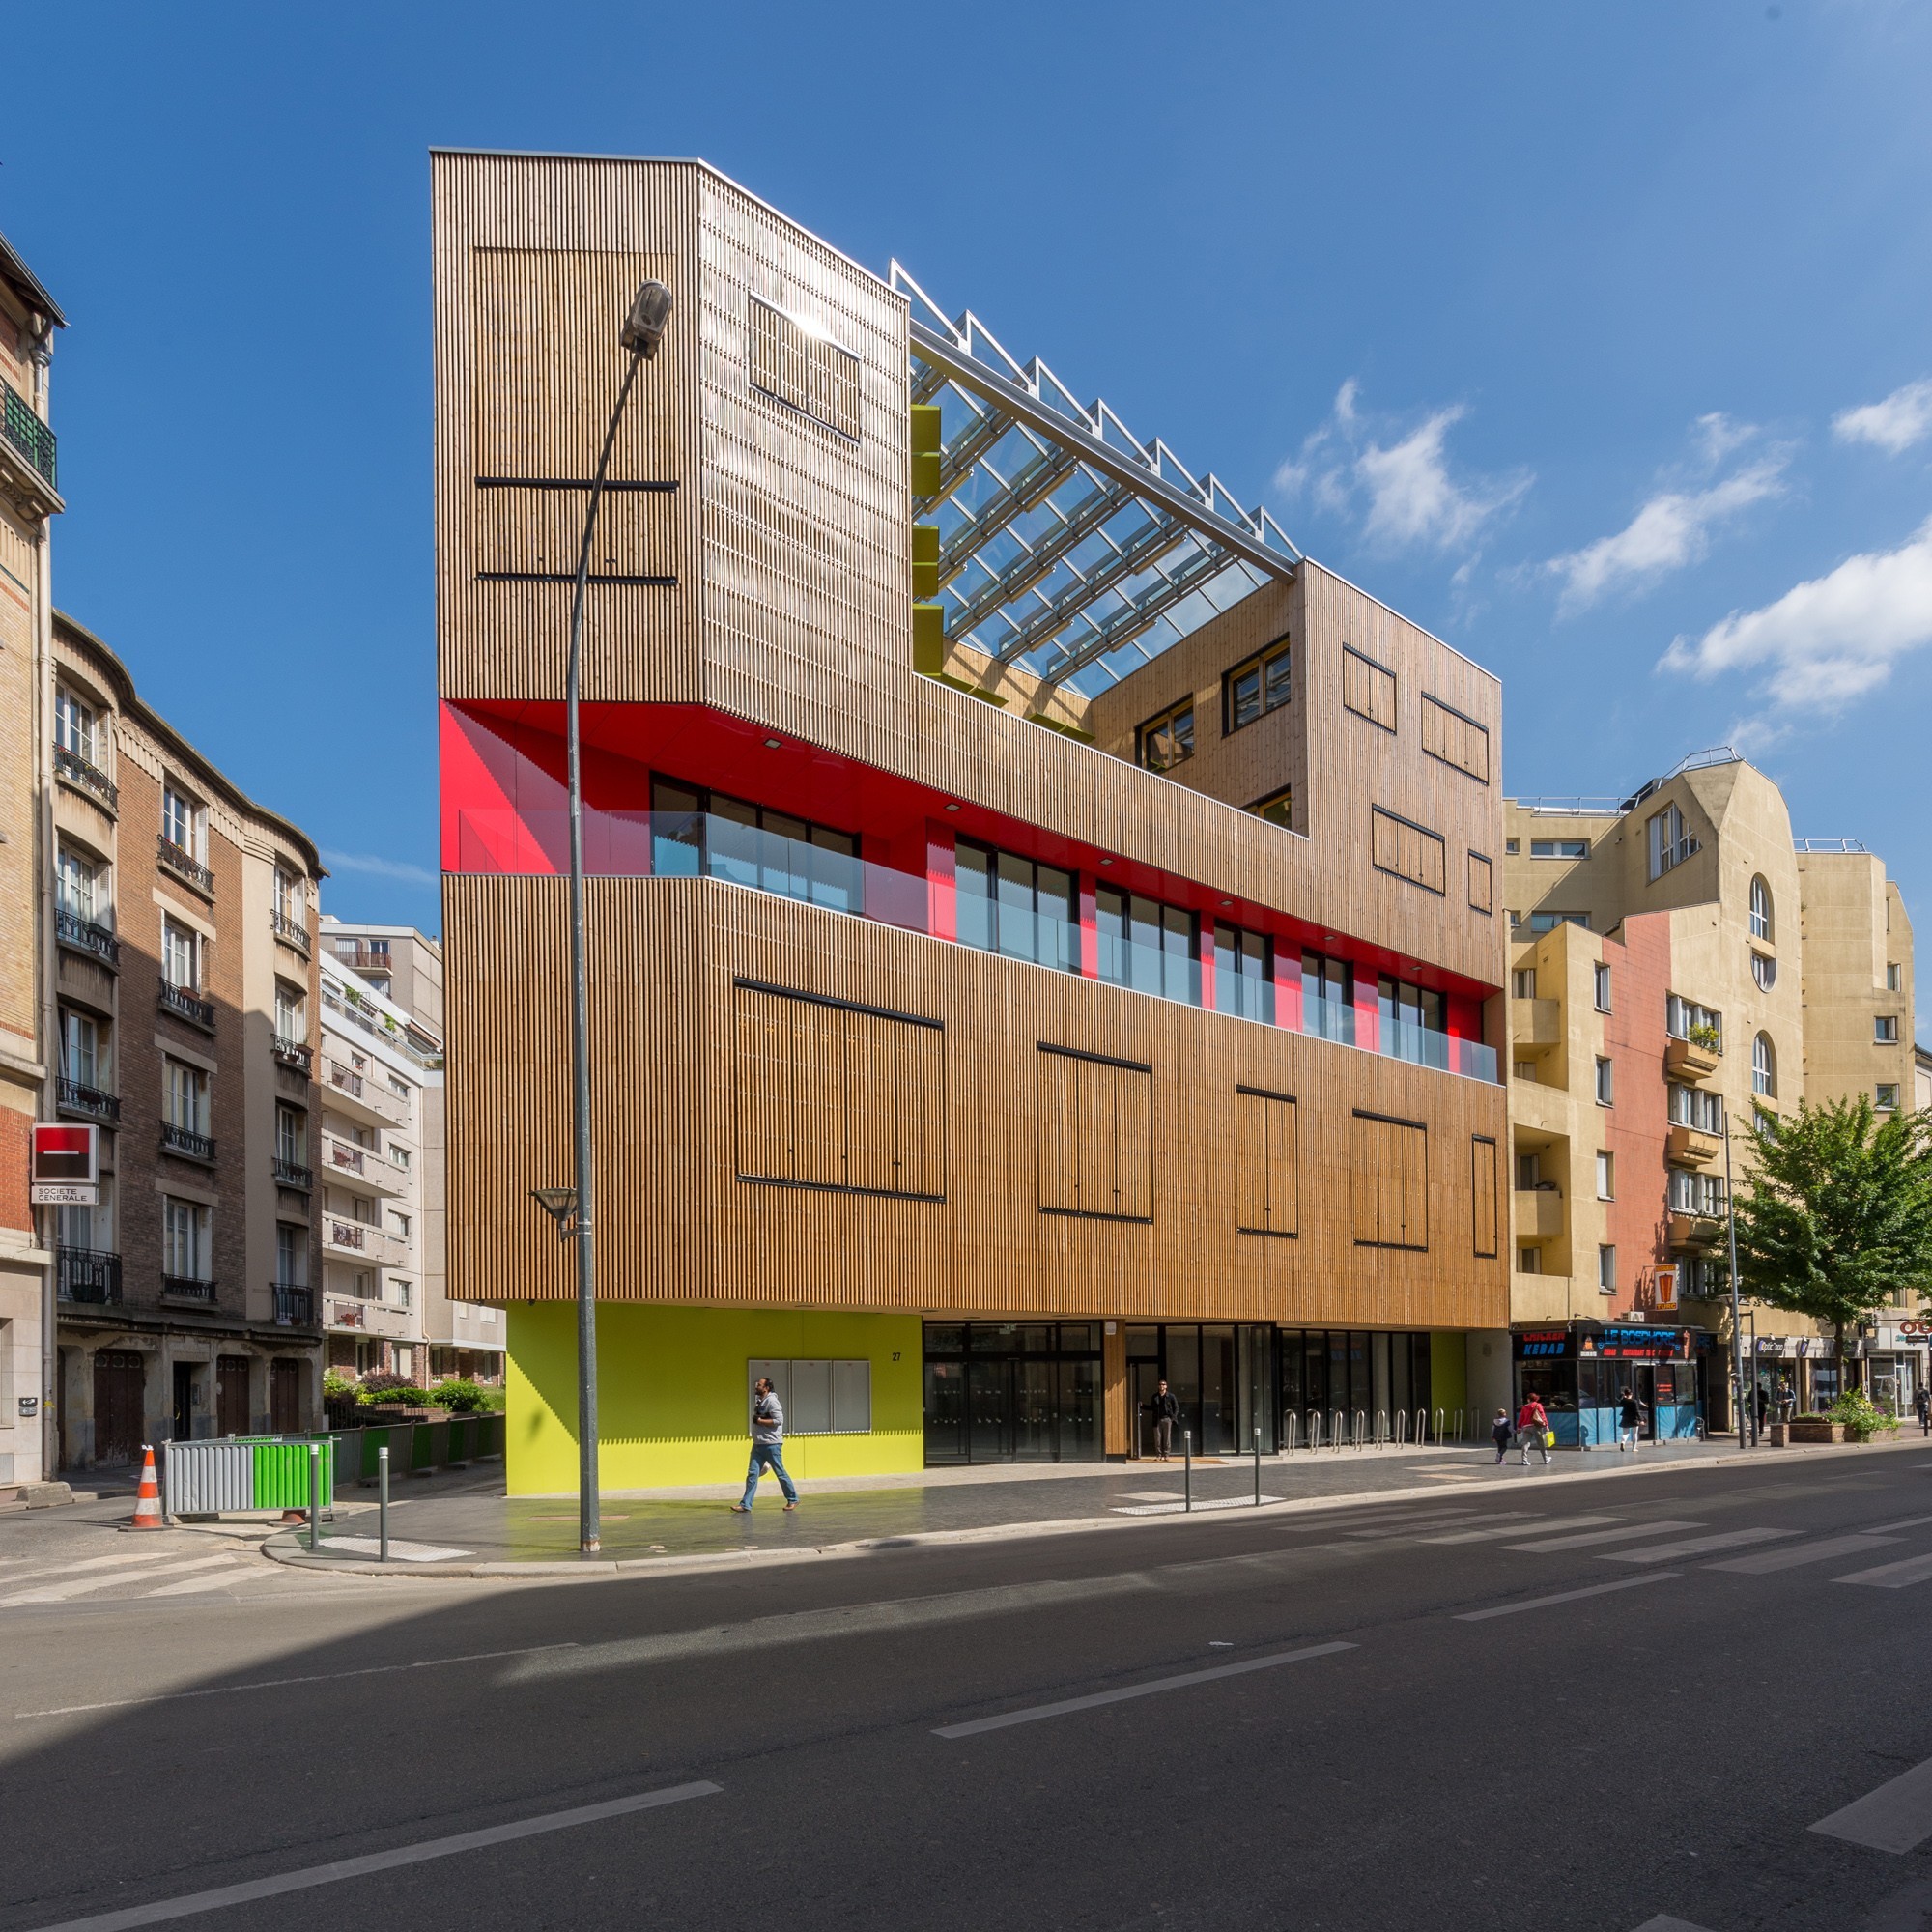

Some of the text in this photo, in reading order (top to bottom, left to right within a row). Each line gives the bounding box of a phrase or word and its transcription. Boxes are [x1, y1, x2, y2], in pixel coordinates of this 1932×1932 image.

[1605, 1328, 1676, 1346] LE BOSPHORE
[1522, 1342, 1566, 1355] KEBAB
[892, 1351, 901, 1362] 27
